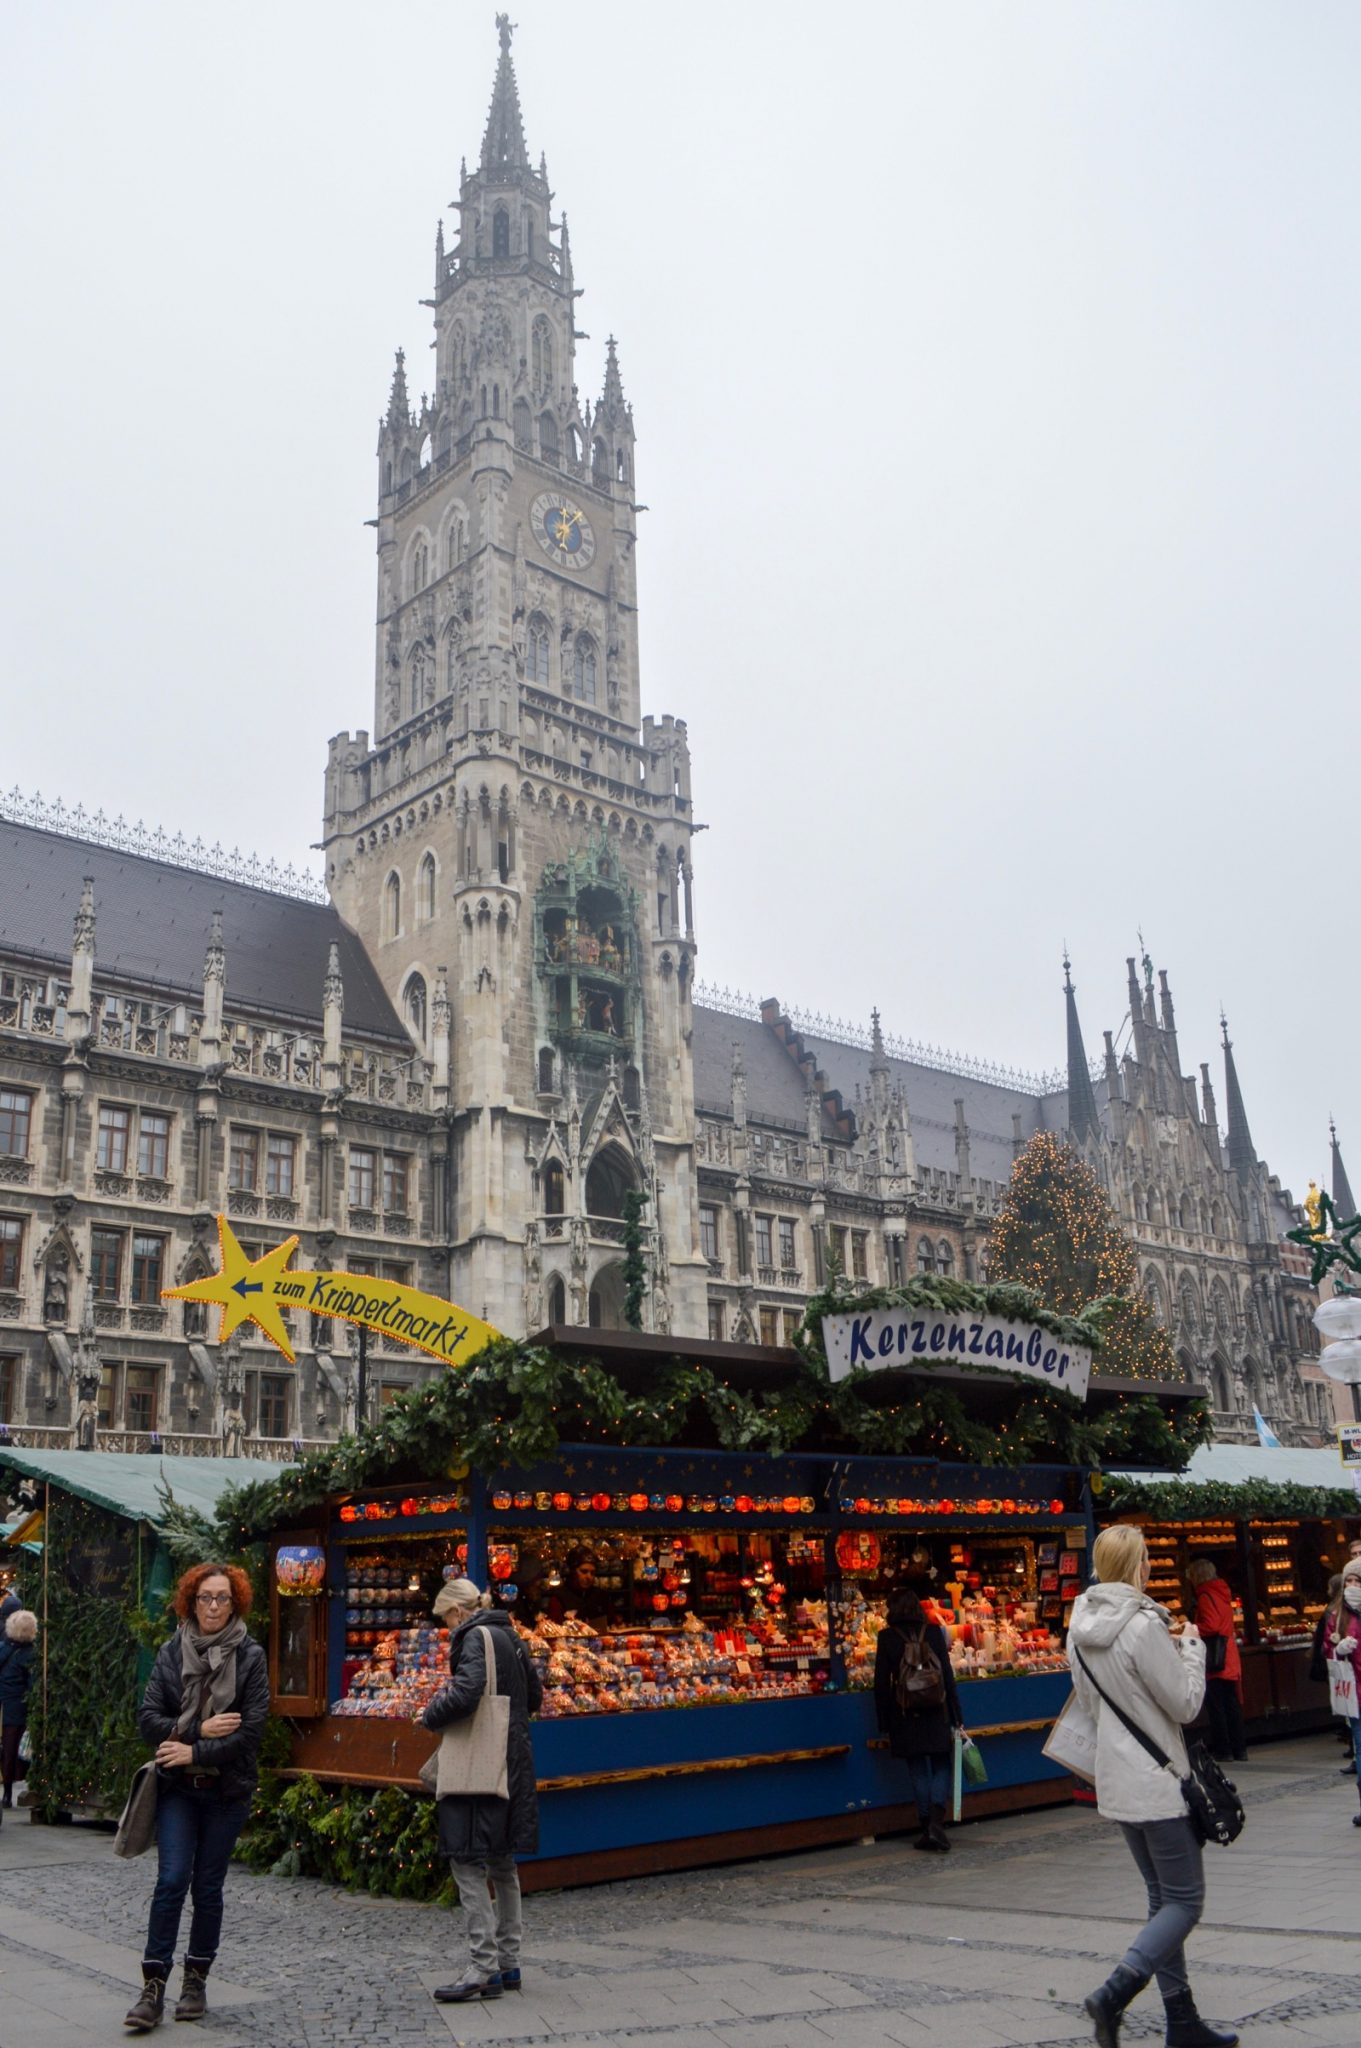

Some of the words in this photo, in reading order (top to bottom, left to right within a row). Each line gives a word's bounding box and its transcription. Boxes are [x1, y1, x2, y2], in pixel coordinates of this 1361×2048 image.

[273, 1281, 306, 1299] zum
[309, 1276, 469, 1356] Kripperlmarkt
[850, 1316, 1069, 1378] Kerzenzauber
